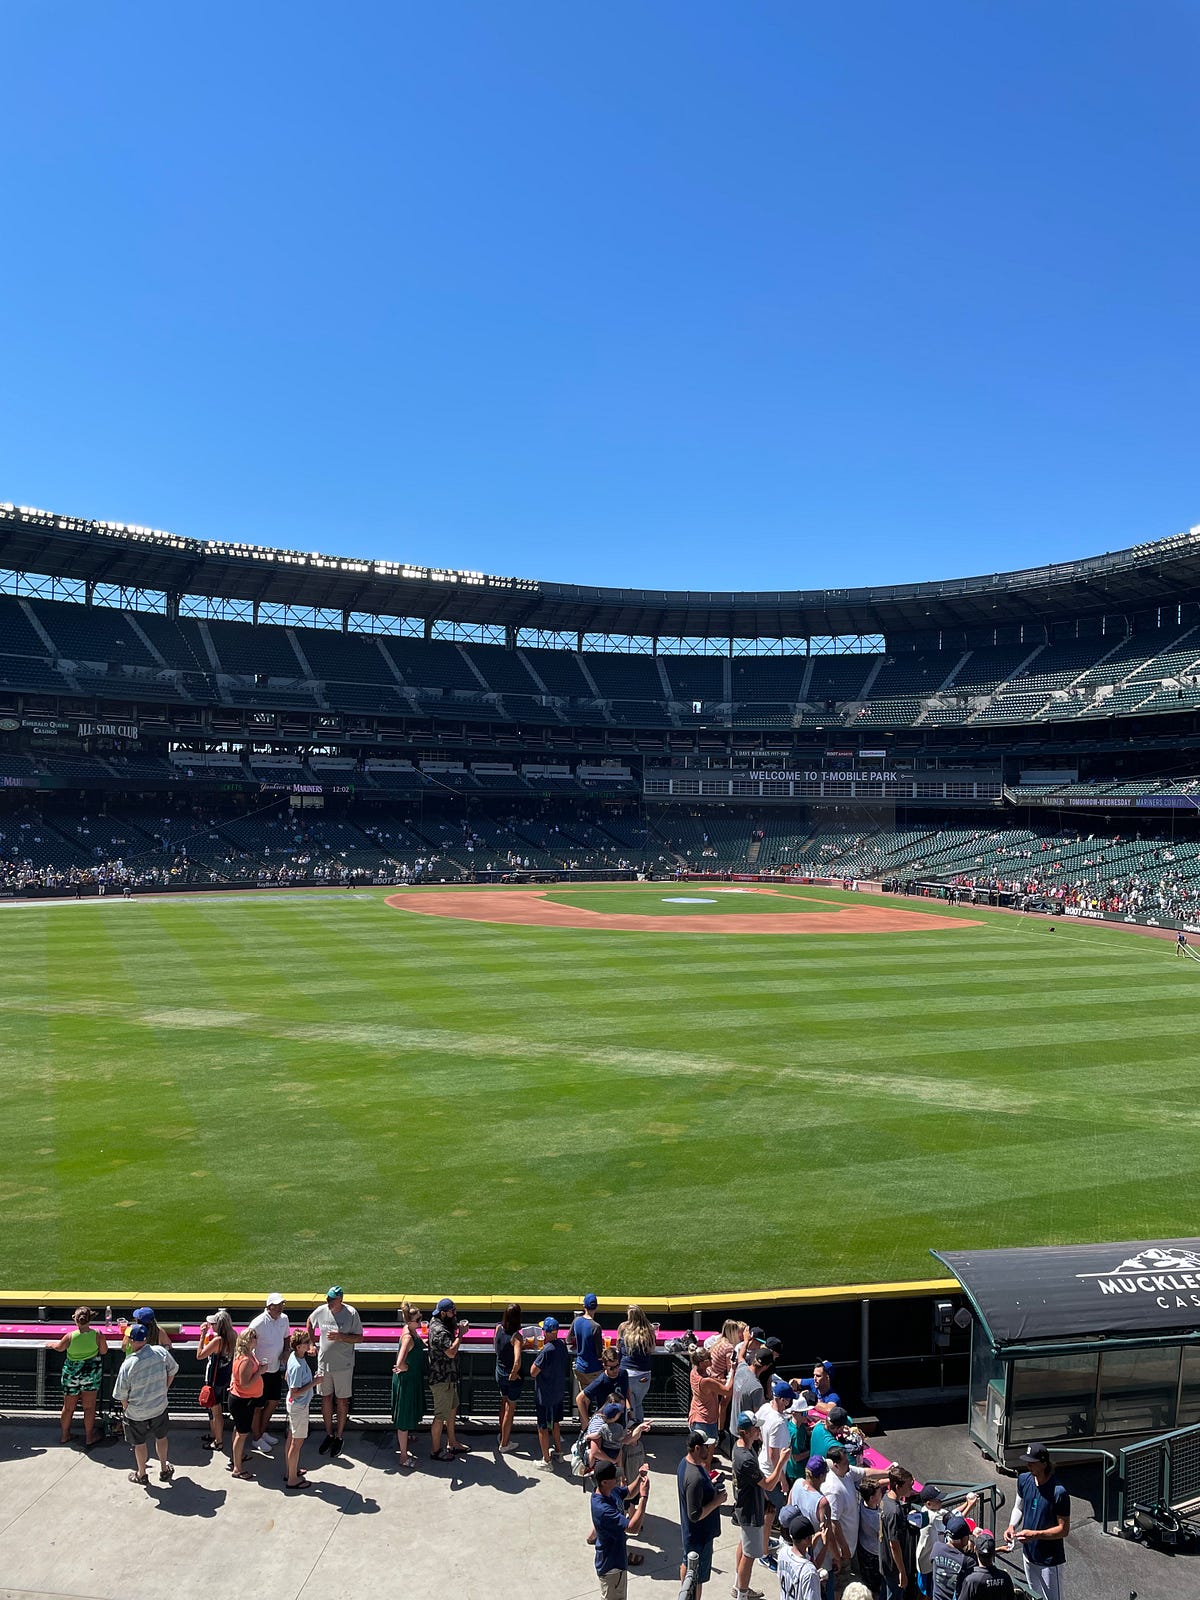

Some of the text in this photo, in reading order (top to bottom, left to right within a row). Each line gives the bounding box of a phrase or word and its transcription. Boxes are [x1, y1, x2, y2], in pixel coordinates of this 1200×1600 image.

[117, 725, 138, 739] CLUB
[750, 771, 898, 781] WELCOME TO T-MOBILE PARK
[293, 783, 323, 793] MARINERS
[372, 877, 392, 885] ROOT
[1065, 906, 1104, 919] ROOT SPORTS
[986, 1578, 1005, 1588] STAFF
